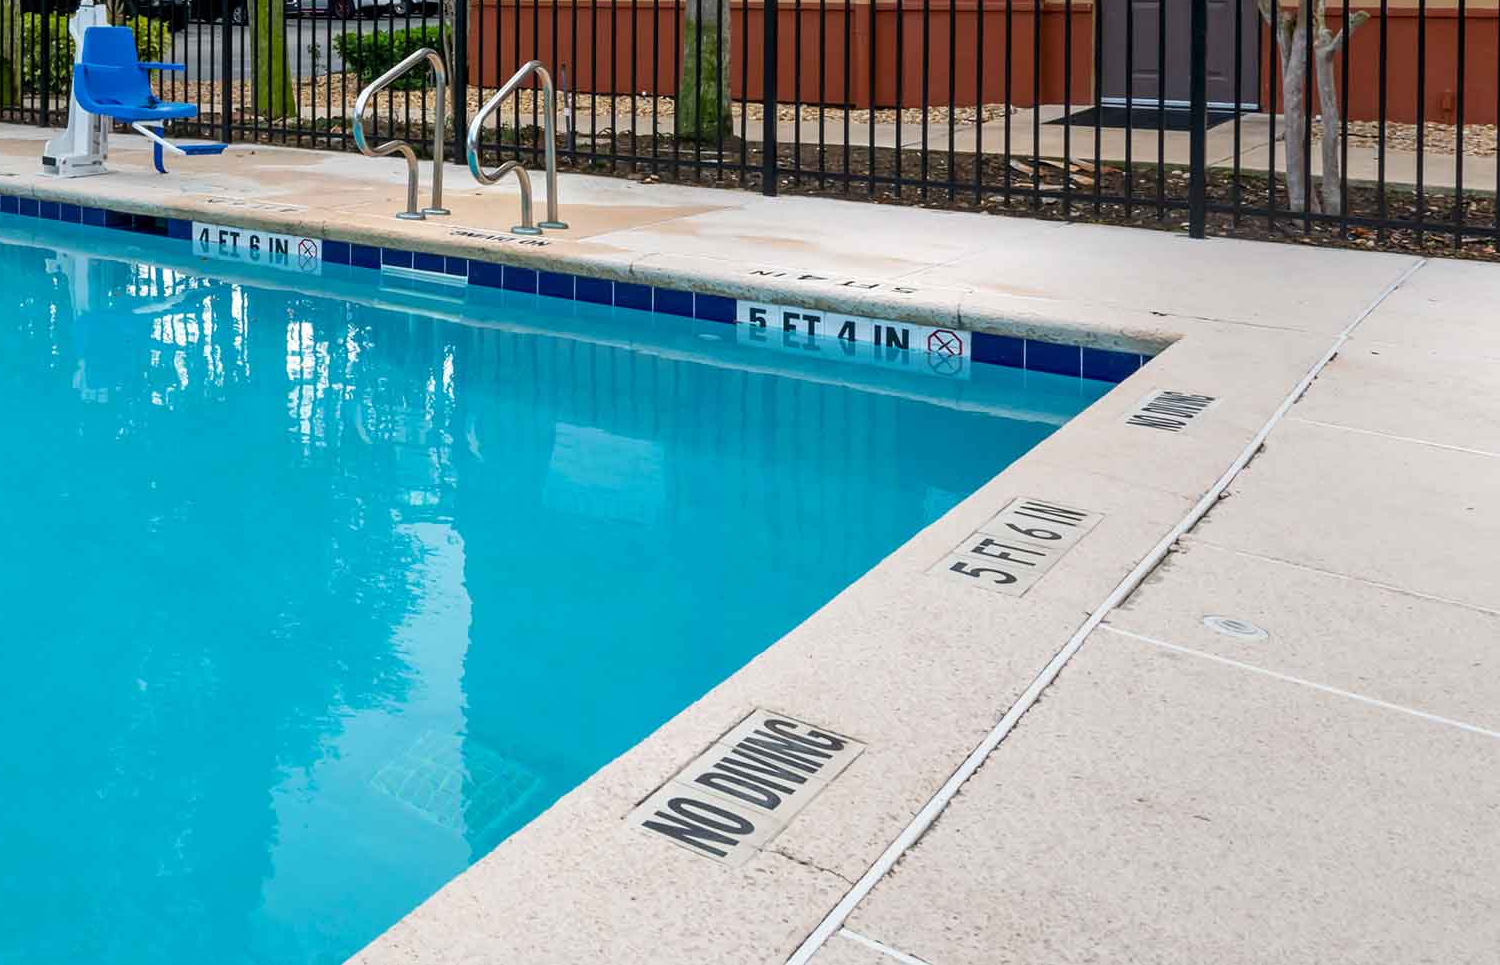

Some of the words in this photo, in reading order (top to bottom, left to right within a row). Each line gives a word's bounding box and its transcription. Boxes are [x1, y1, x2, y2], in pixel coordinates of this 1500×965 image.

[219, 230, 240, 247] FT
[250, 235, 261, 252] 6
[268, 237, 288, 254] IN
[749, 307, 767, 329] 5
[783, 311, 821, 337] FT
[838, 320, 856, 343] 4
[874, 324, 910, 351] IN
[1125, 415, 1187, 432] NO
[1013, 501, 1088, 527] IN
[1005, 522, 1063, 541] 6
[971, 538, 1047, 566] FT
[950, 561, 1018, 585] 5
[693, 719, 849, 811] DIVING
[641, 797, 755, 858] NO
